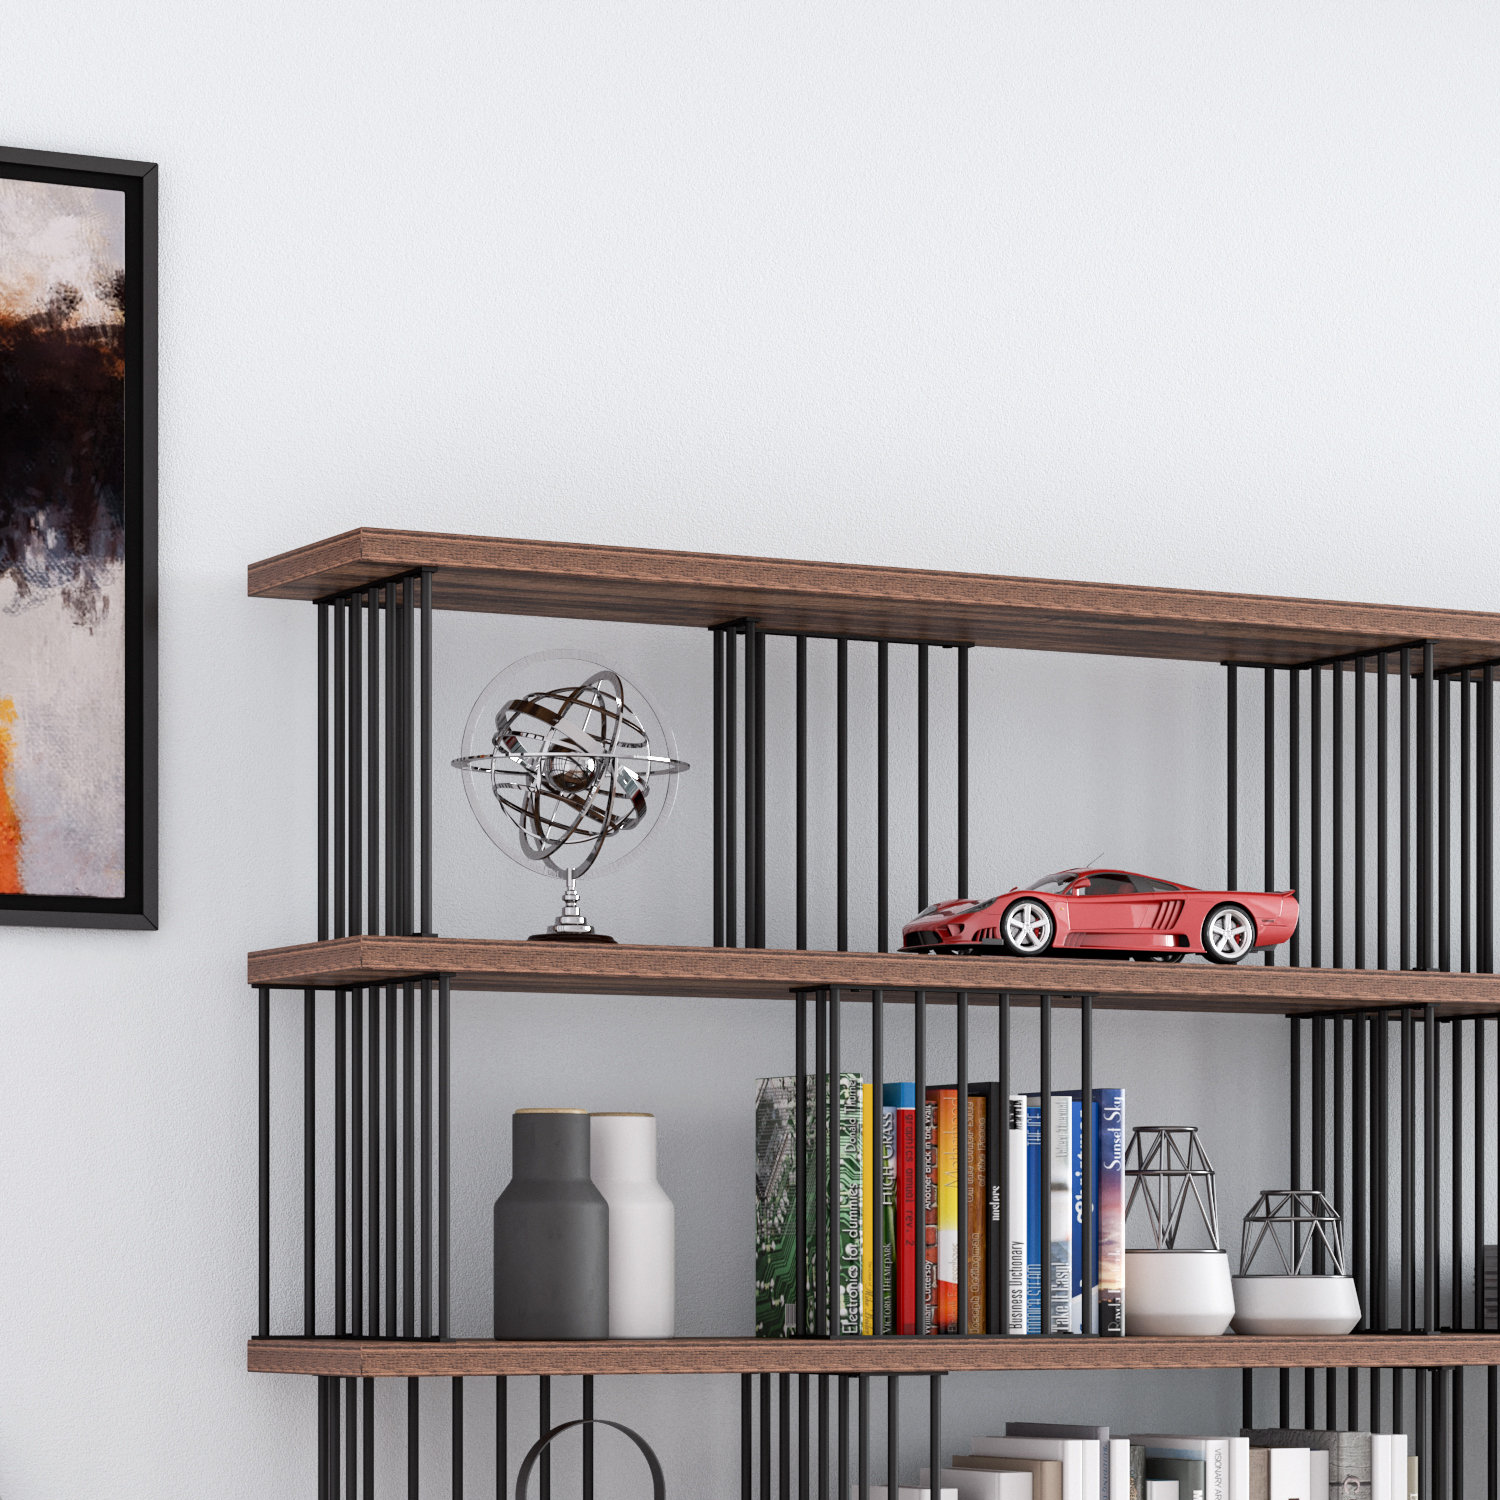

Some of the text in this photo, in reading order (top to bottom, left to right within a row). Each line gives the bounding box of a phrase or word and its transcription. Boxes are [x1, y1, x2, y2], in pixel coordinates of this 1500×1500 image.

[1104, 1096, 1124, 1171] Sunset Sky
[904, 1113, 914, 1247] graphics annual rev. 2
[842, 1183, 858, 1333] Electronics for dummies
[1009, 1240, 1024, 1330] Business Dictionary
[1051, 1262, 1073, 1333] Take It Easy!
